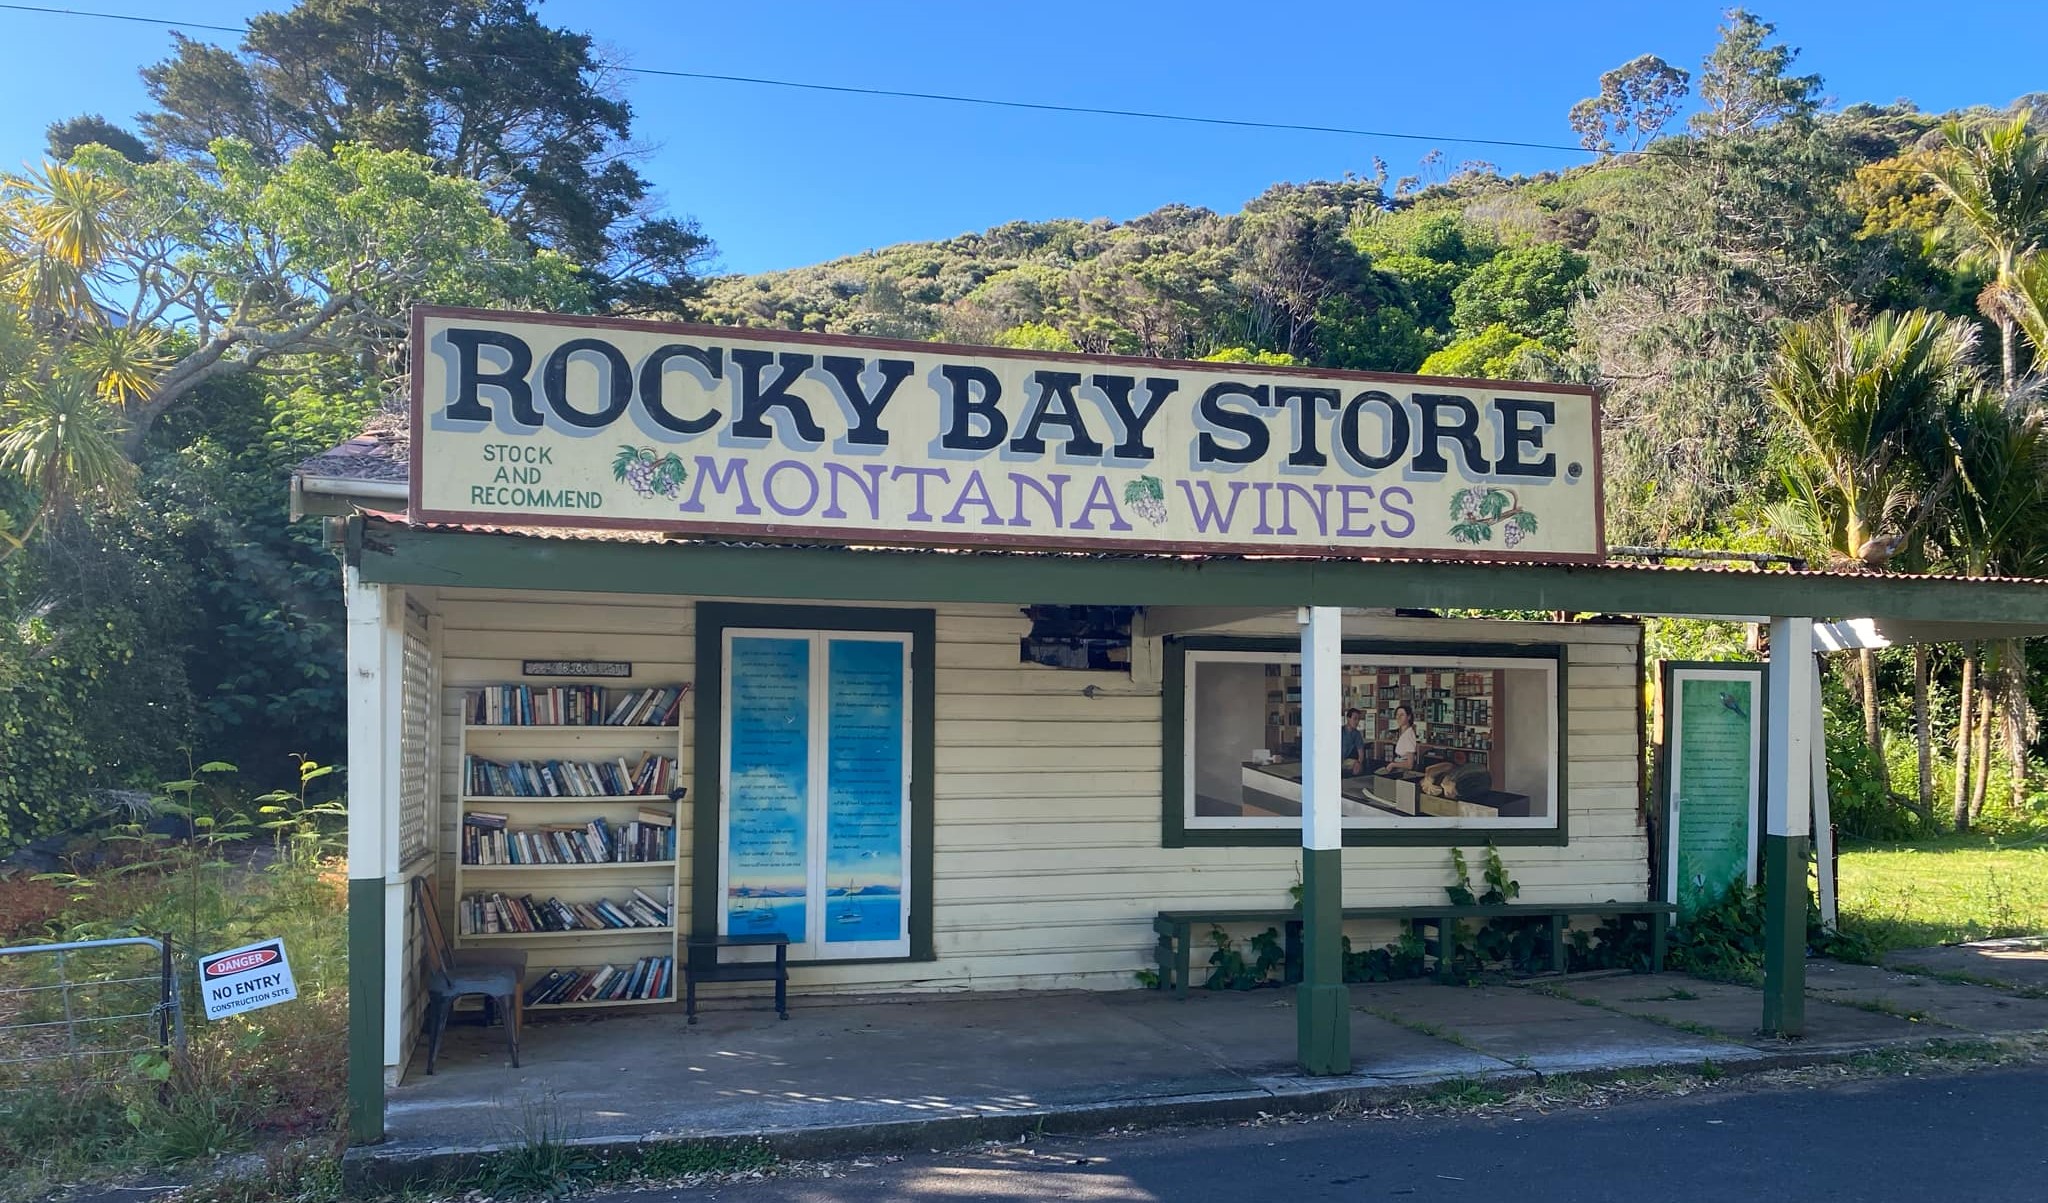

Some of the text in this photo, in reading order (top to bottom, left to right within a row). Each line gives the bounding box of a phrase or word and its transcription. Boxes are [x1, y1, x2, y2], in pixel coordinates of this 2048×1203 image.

[442, 326, 915, 447] ROCKY
[938, 363, 1180, 461] BAY
[483, 444, 553, 465] STOCK
[493, 465, 542, 485] AND
[470, 485, 603, 509] RECOMMEND
[678, 454, 1416, 539] MONTANA WINES
[217, 953, 264, 973] DANGER
[212, 972, 281, 1001] NO ENTRY
[211, 987, 289, 1013] CONSTRUCTION SITE
